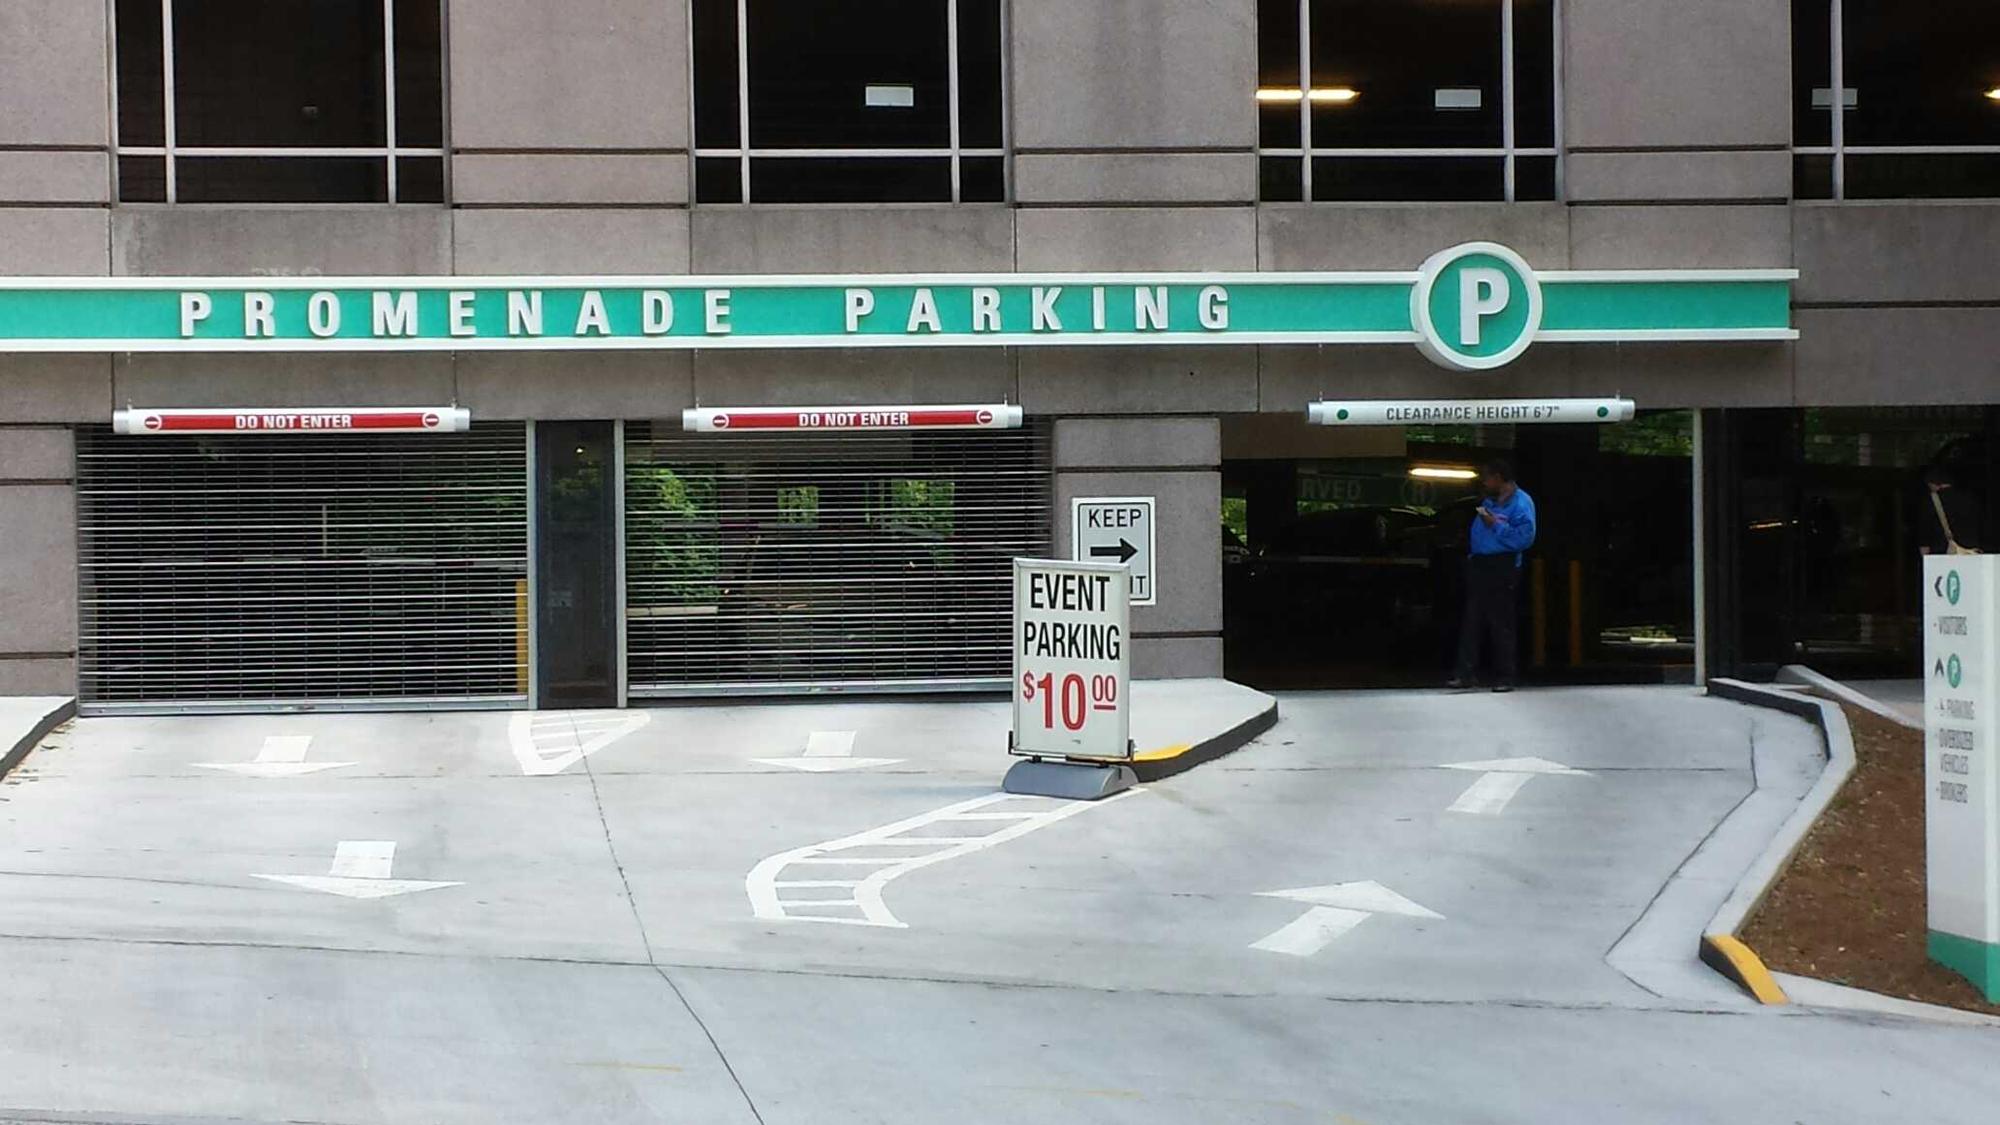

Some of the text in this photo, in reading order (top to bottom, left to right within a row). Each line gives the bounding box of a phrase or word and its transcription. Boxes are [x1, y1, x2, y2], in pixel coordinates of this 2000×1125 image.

[180, 285, 1230, 338] PROMENADE PARKING
[1458, 267, 1510, 346] P
[235, 414, 352, 429] DO NOT ENTER
[799, 412, 910, 427] DO NOT ENTER
[1386, 405, 1560, 421] CLEARANCE HEIGHT 6'7"
[1088, 508, 1142, 528] KEEP
[1030, 572, 1111, 612] EVENT
[1023, 621, 1121, 661] PARKING
